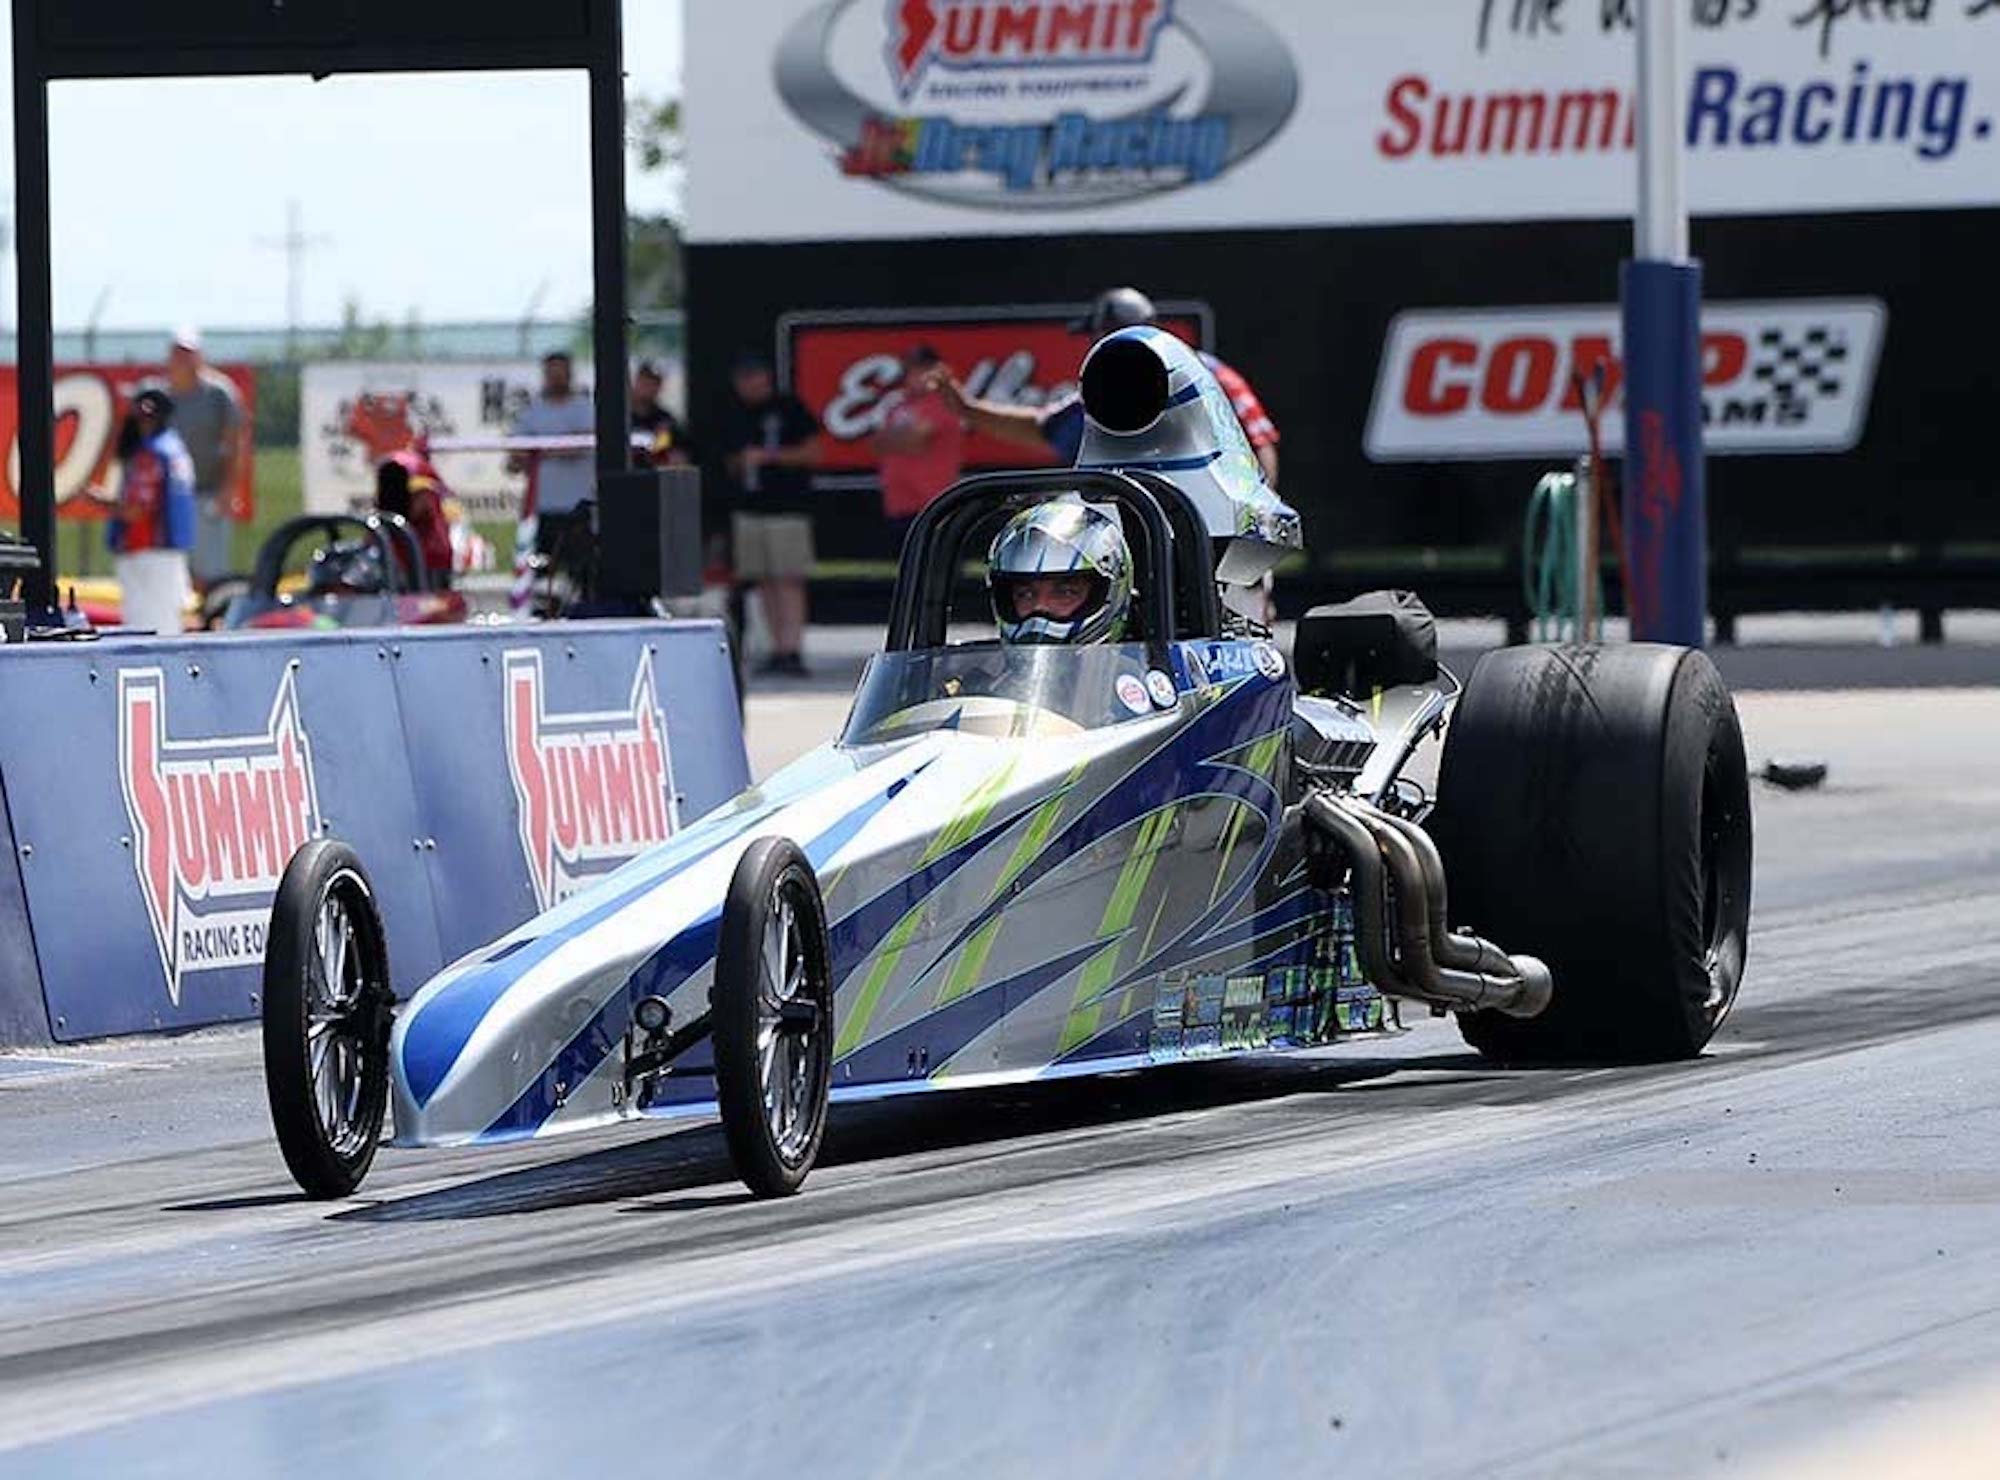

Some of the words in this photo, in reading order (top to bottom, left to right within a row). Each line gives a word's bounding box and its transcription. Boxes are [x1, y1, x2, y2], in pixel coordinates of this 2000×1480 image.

[897, 0, 1160, 72] SUMMIT
[129, 698, 308, 930] SUMMIT
[509, 677, 669, 885] SUMMIT
[182, 924, 240, 962] RACING
